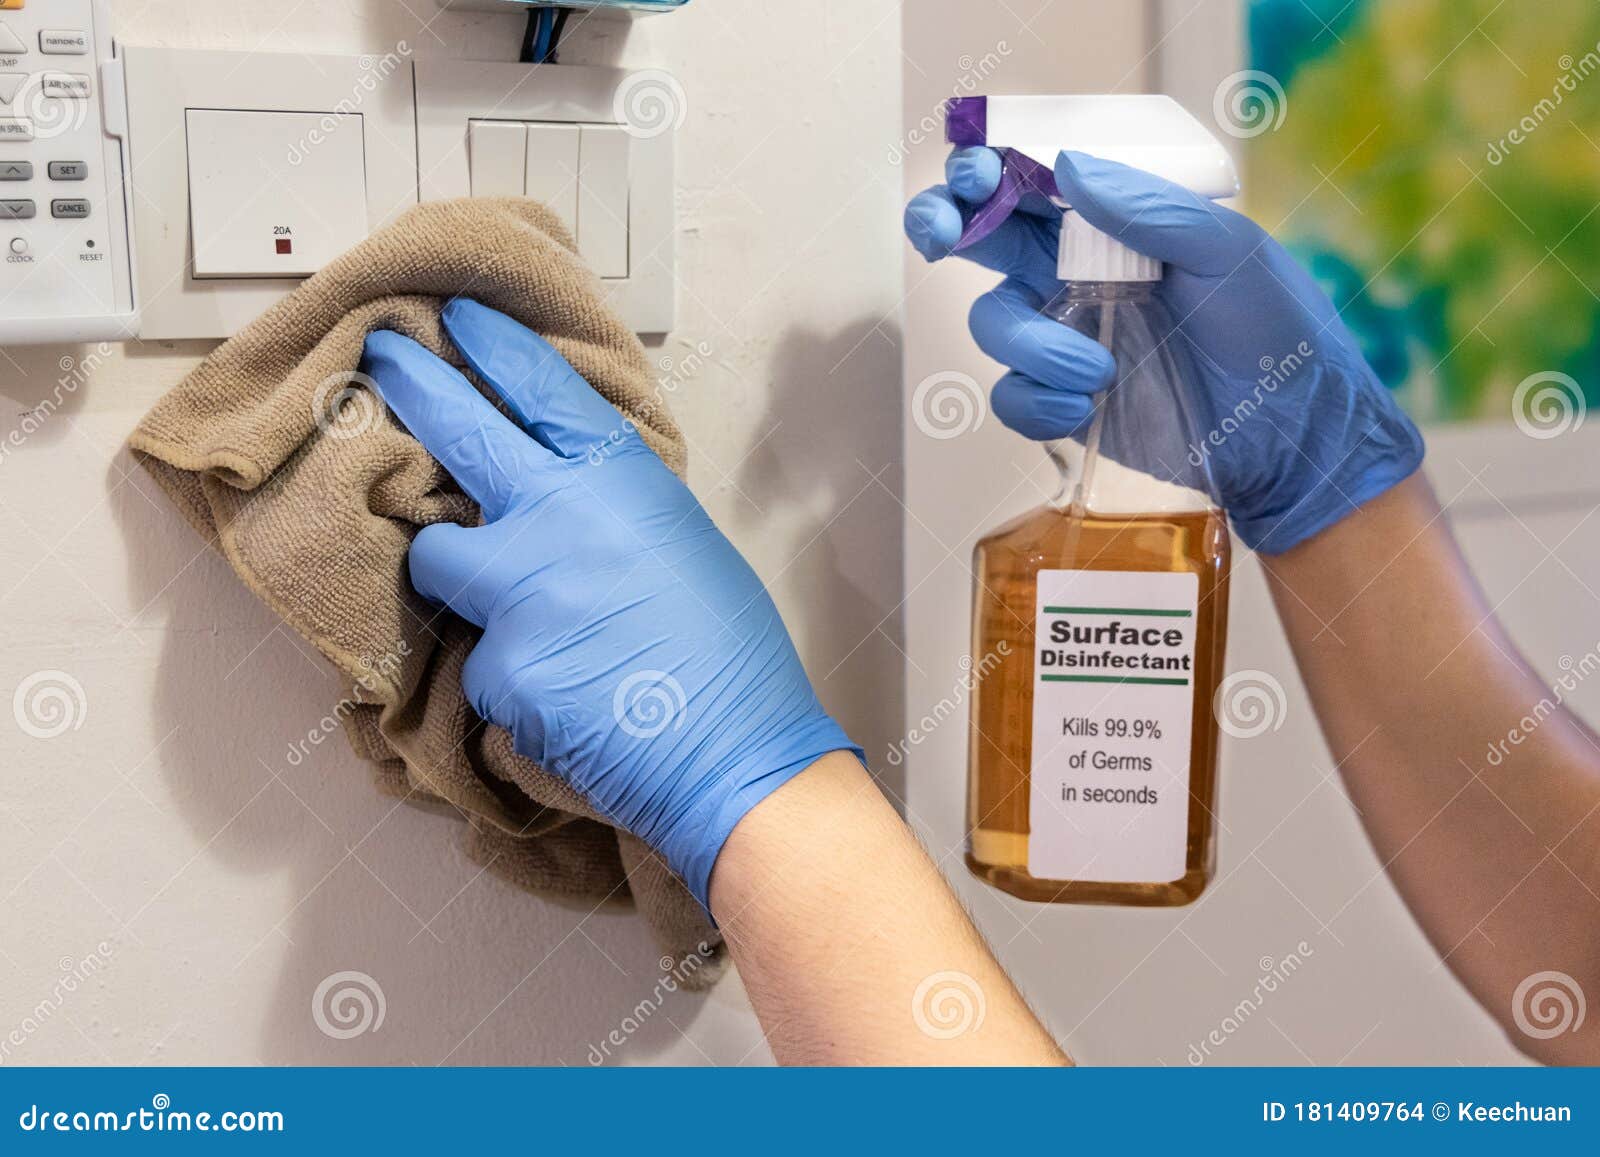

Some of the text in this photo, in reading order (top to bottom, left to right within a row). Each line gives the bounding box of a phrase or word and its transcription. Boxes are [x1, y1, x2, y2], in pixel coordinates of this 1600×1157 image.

[59, 166, 77, 175] SET
[56, 204, 87, 213] CANCEL
[273, 225, 292, 235] 20A
[6, 255, 34, 263] CLOCK
[79, 253, 104, 262] RESET
[1050, 620, 1183, 647] Surface
[1040, 650, 1190, 670] Disinfectant
[1062, 717, 1162, 739] Kills 99.9%
[1068, 751, 1152, 771] of Germs
[1061, 783, 1157, 804] in seconds
